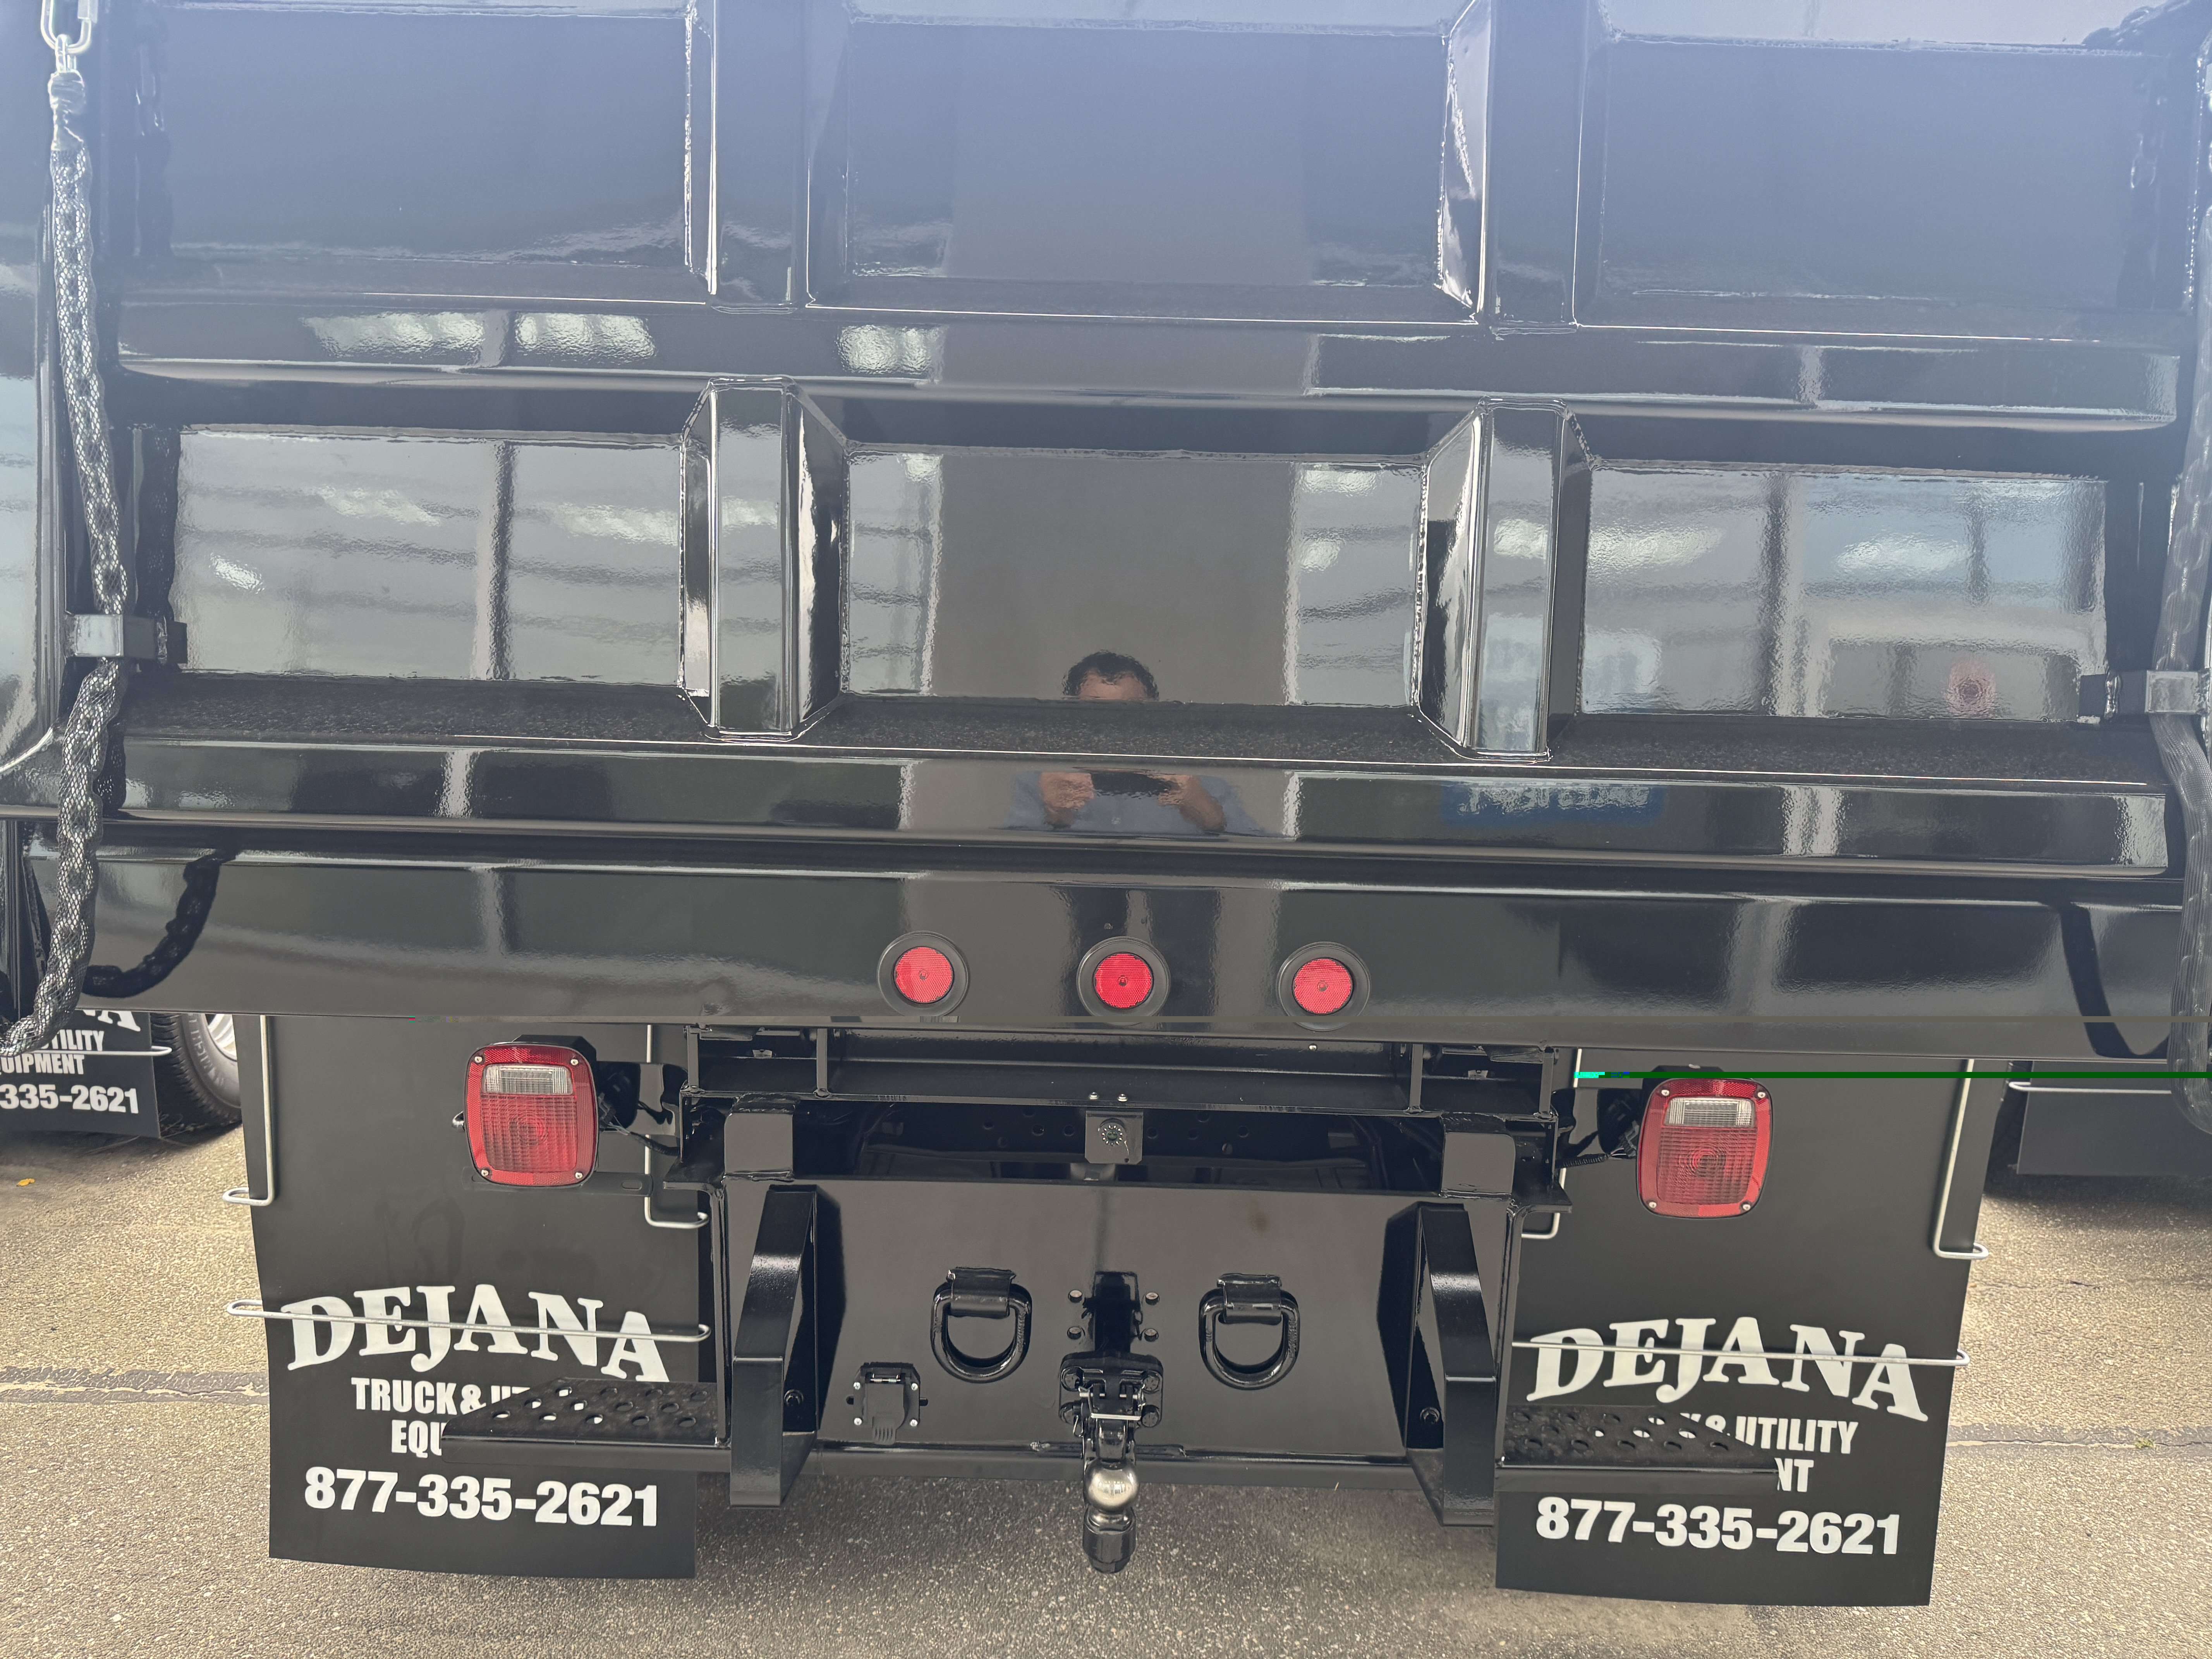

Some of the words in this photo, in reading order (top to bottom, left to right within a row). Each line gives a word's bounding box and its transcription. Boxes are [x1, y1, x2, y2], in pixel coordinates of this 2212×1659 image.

[0, 1053, 85, 1075] UIPMENT
[41, 1029, 104, 1051] ILITY
[281, 1284, 670, 1382] DEJANA
[1526, 1317, 1928, 1422] DEJANA
[1735, 1416, 1859, 1454] UTILITY
[304, 1466, 657, 1527] 877-335-2621
[1536, 1496, 1900, 1554] 877-335-2621
